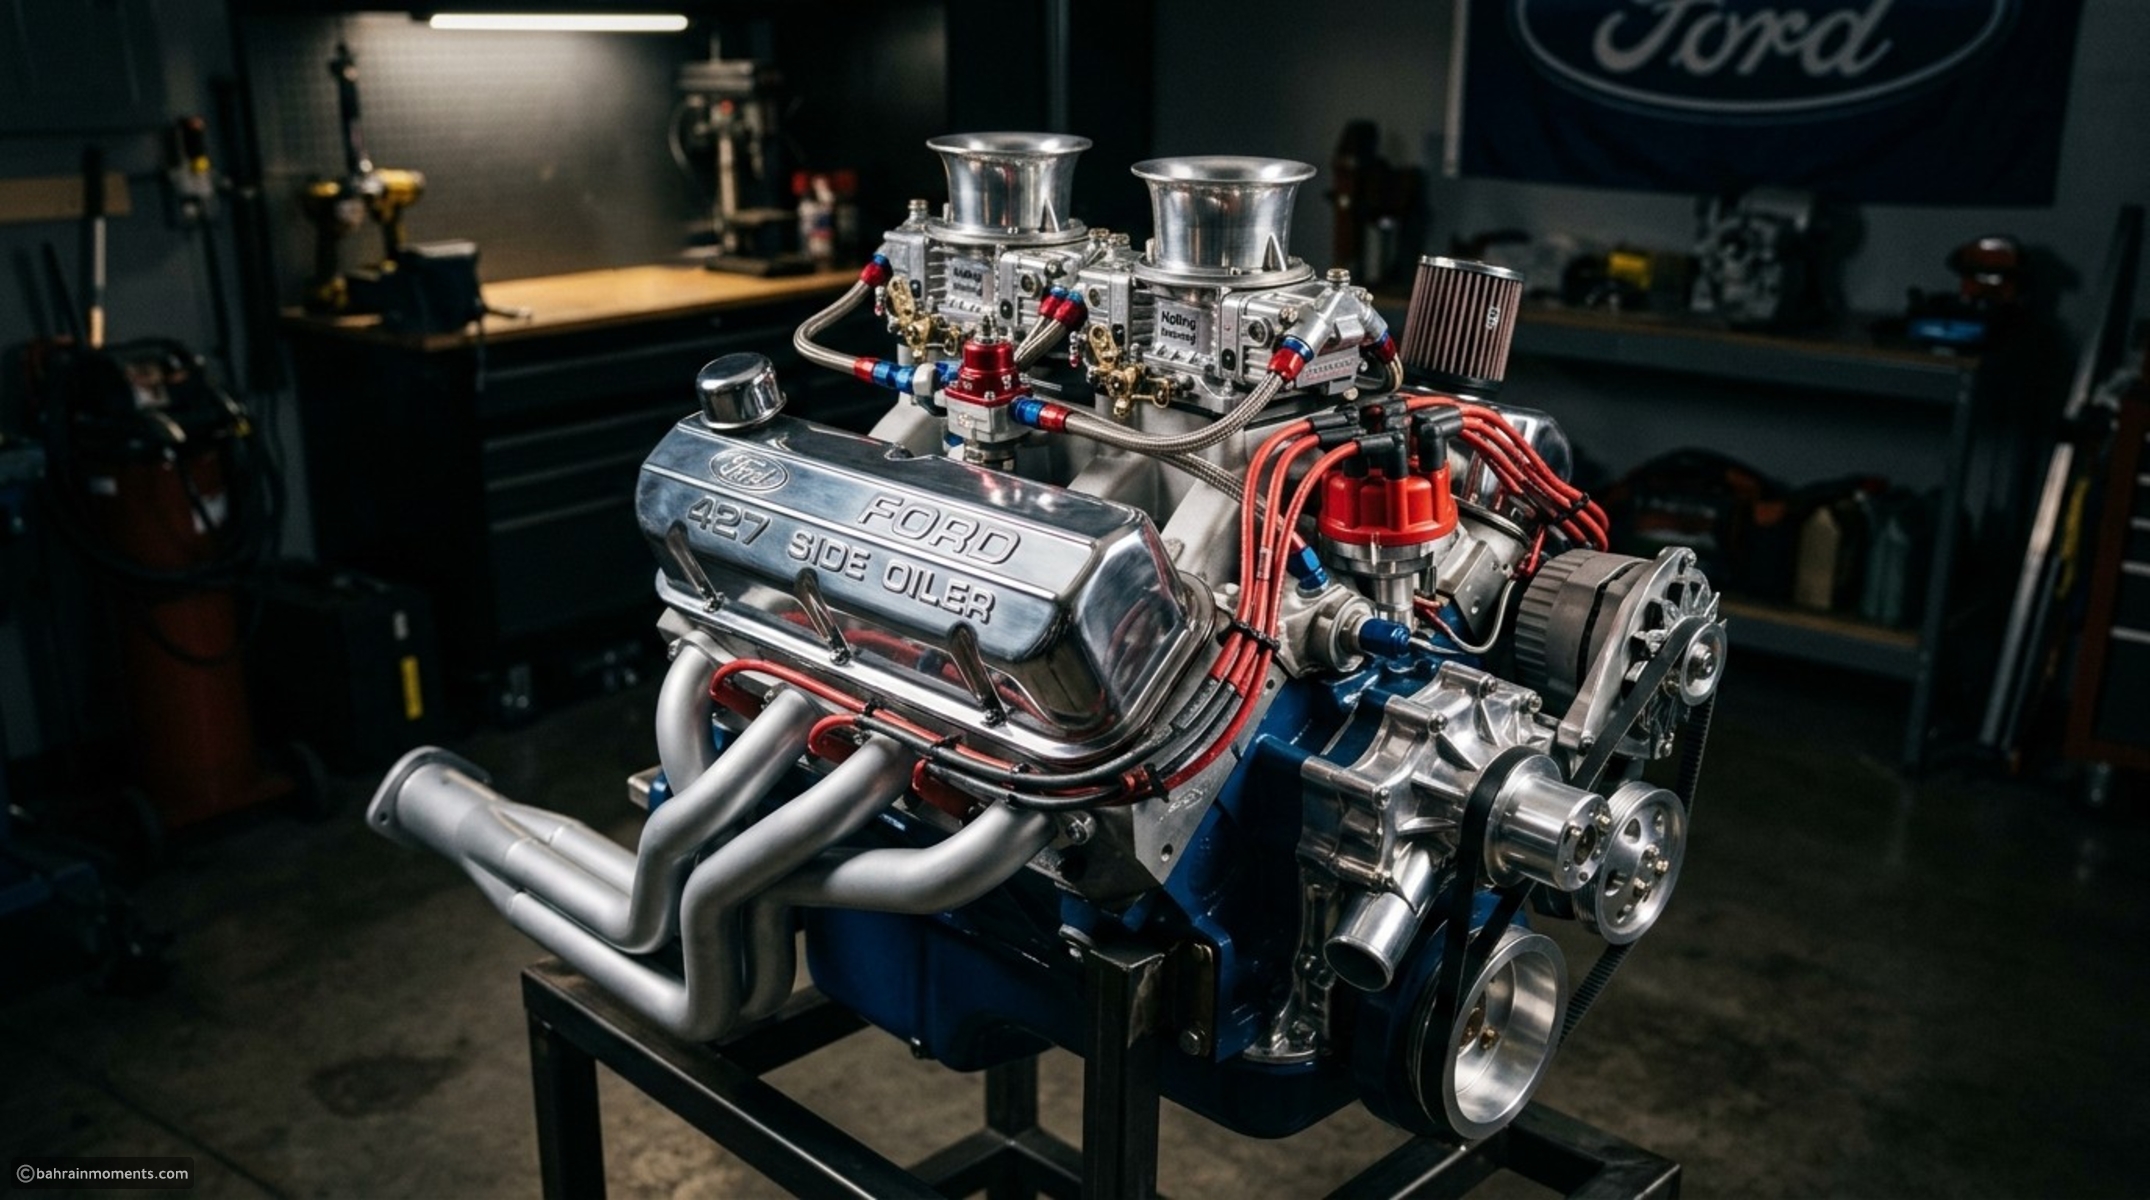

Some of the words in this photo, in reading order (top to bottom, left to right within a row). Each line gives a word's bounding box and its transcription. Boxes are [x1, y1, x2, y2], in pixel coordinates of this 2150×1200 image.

[1592, 0, 1893, 76] Ford
[687, 495, 772, 546] 427
[787, 530, 871, 582] SIDE
[882, 558, 996, 625] OILER
[858, 492, 1021, 565] FORD
